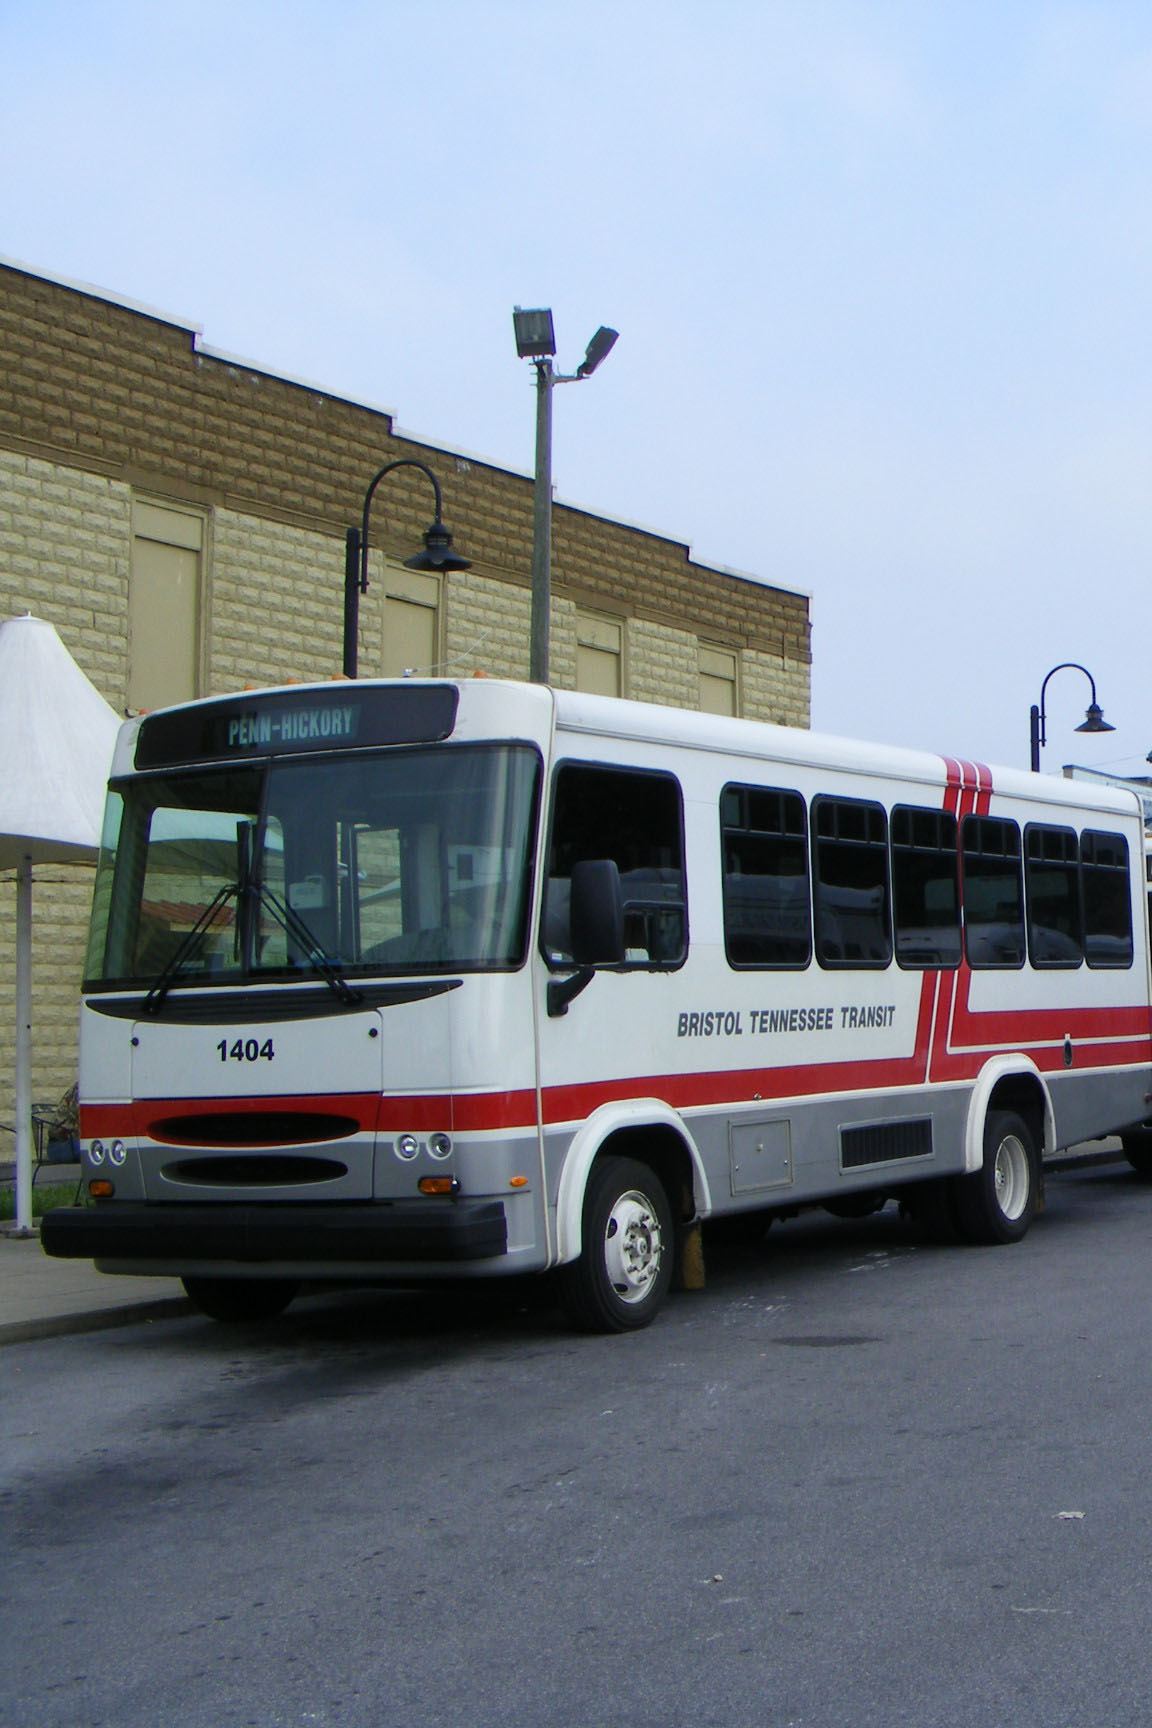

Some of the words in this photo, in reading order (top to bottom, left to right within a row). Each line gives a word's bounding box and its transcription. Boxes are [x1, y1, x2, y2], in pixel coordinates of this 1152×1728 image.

[228, 708, 353, 746] PENN-HICKORY
[677, 1011, 743, 1037] BRISTOL
[749, 1007, 834, 1034] TENNESSEE
[840, 1005, 896, 1029] TRANSIT
[216, 1038, 275, 1062] 1404
